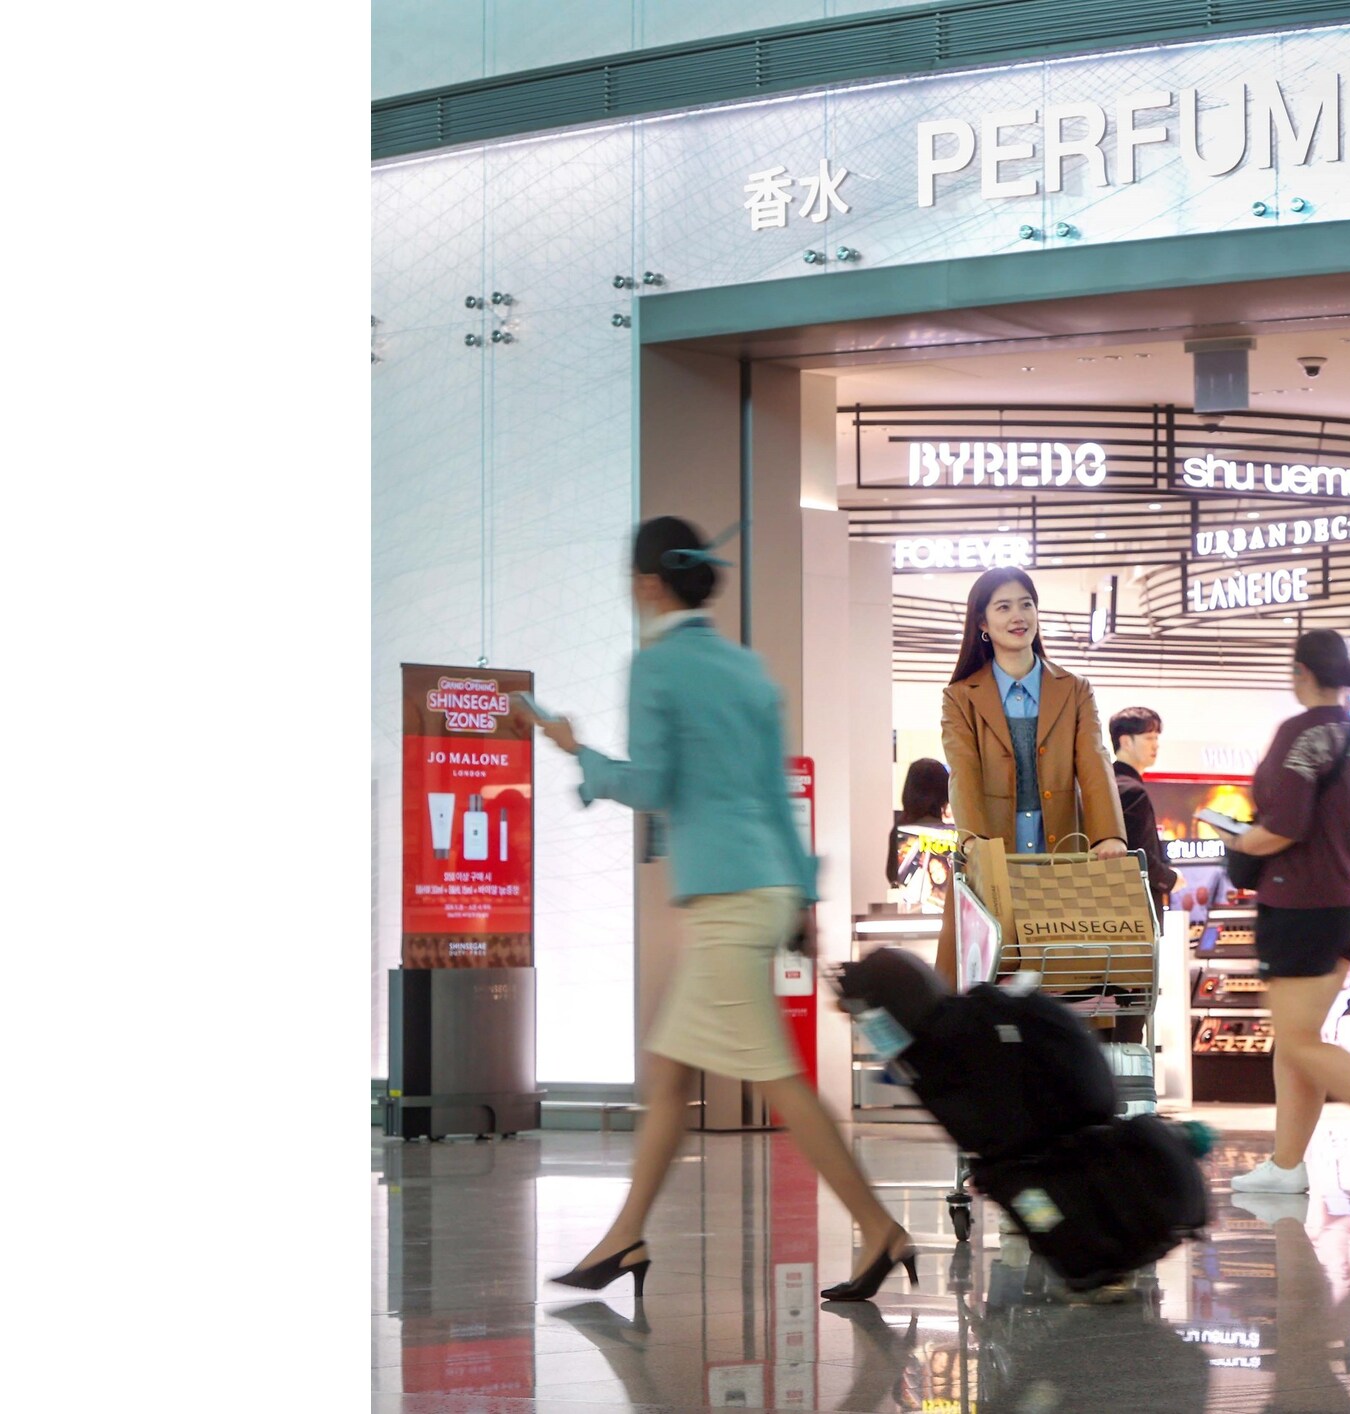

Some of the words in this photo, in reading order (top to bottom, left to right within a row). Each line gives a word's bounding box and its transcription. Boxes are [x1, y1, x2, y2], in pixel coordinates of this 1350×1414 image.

[743, 158, 851, 231] 香水
[907, 441, 1107, 487] BYREDO
[1182, 453, 1255, 492] shu
[894, 537, 956, 569] FOR
[959, 536, 1033, 568] EVER
[1196, 522, 1287, 559] URBAN
[1192, 568, 1309, 613] LANEIGE
[440, 679, 464, 691] GRAND
[465, 681, 496, 692] OPENING
[429, 692, 507, 712] SHINSEGAE
[448, 711, 489, 729] ZONE
[427, 752, 446, 764] JO
[449, 753, 509, 766] MALONE
[452, 769, 487, 778] LONDON
[1023, 920, 1145, 936] SHINSEGAE
